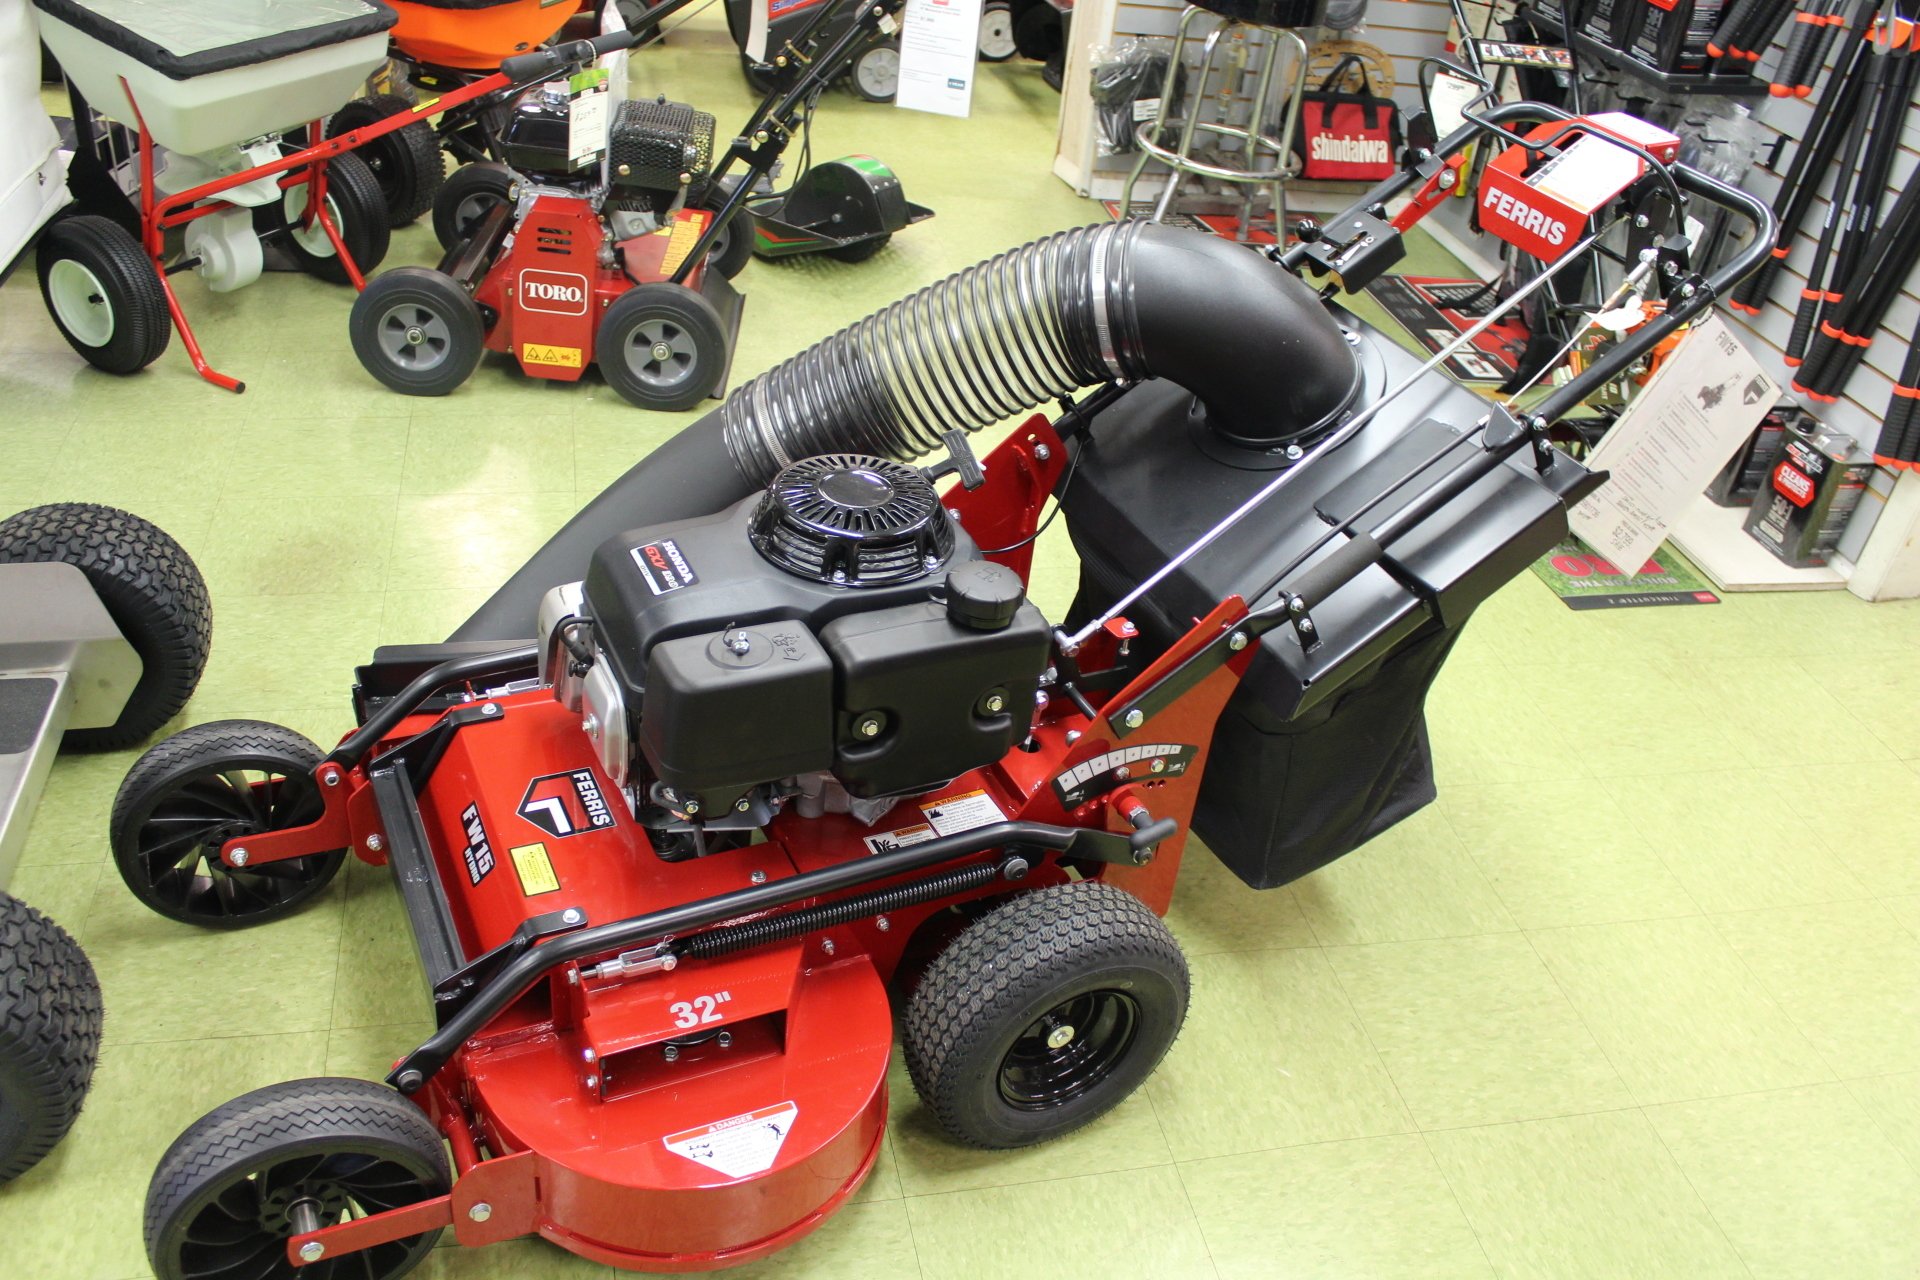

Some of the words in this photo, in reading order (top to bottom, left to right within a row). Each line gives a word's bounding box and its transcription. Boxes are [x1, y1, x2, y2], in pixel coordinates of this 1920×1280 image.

[1311, 132, 1389, 164] shindaiwa
[1483, 186, 1567, 246] FERRIS
[525, 282, 582, 302] TORO
[1716, 331, 1739, 356] FW15
[1781, 465, 1811, 492] CLEANS
[661, 540, 694, 584] HONDA
[573, 771, 610, 826] FERRIS
[941, 794, 972, 806] WARNING
[900, 825, 929, 836] WARNING
[464, 847, 481, 884] HYDRO
[669, 991, 731, 1029] 32"
[717, 1114, 754, 1129] DANGER
